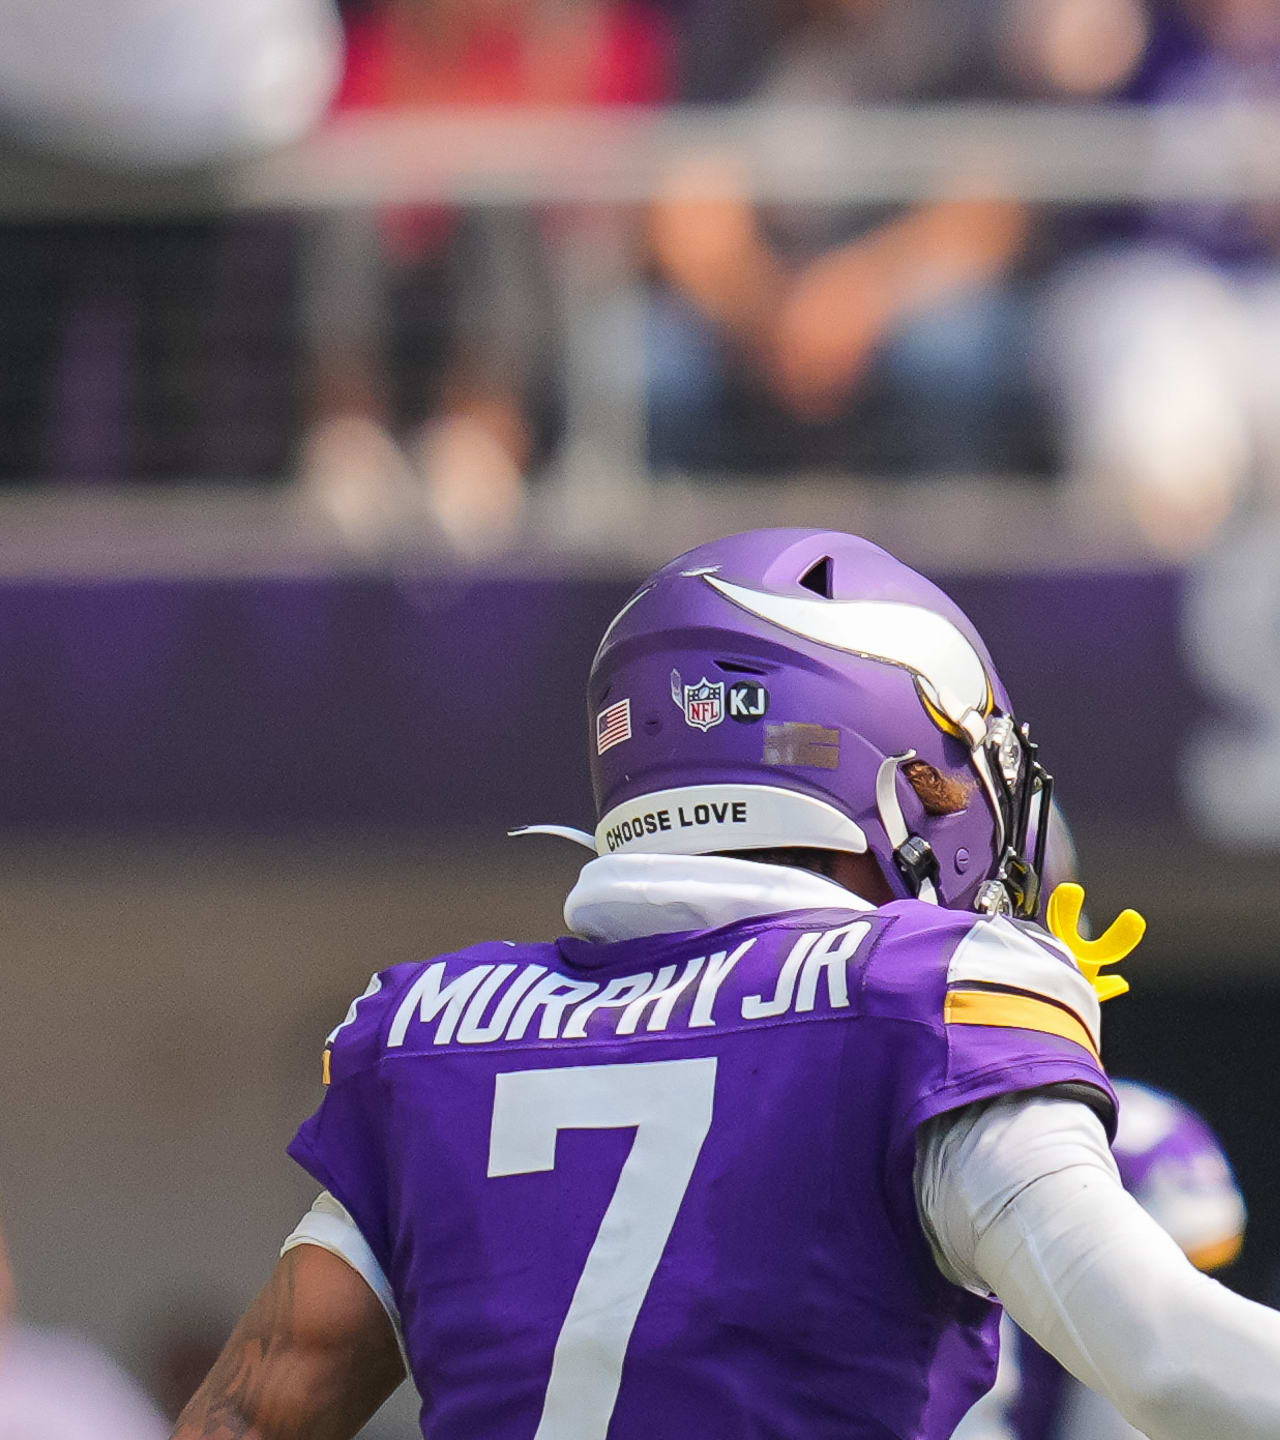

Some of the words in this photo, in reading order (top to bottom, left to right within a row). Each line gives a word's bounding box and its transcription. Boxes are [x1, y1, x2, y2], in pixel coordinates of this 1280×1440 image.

[691, 701, 718, 722] NFL
[730, 687, 765, 716] KJ
[606, 810, 672, 852] CHOOSE
[679, 802, 747, 827] LOVE
[387, 937, 758, 1048] MURPHY
[741, 920, 872, 1020] JR
